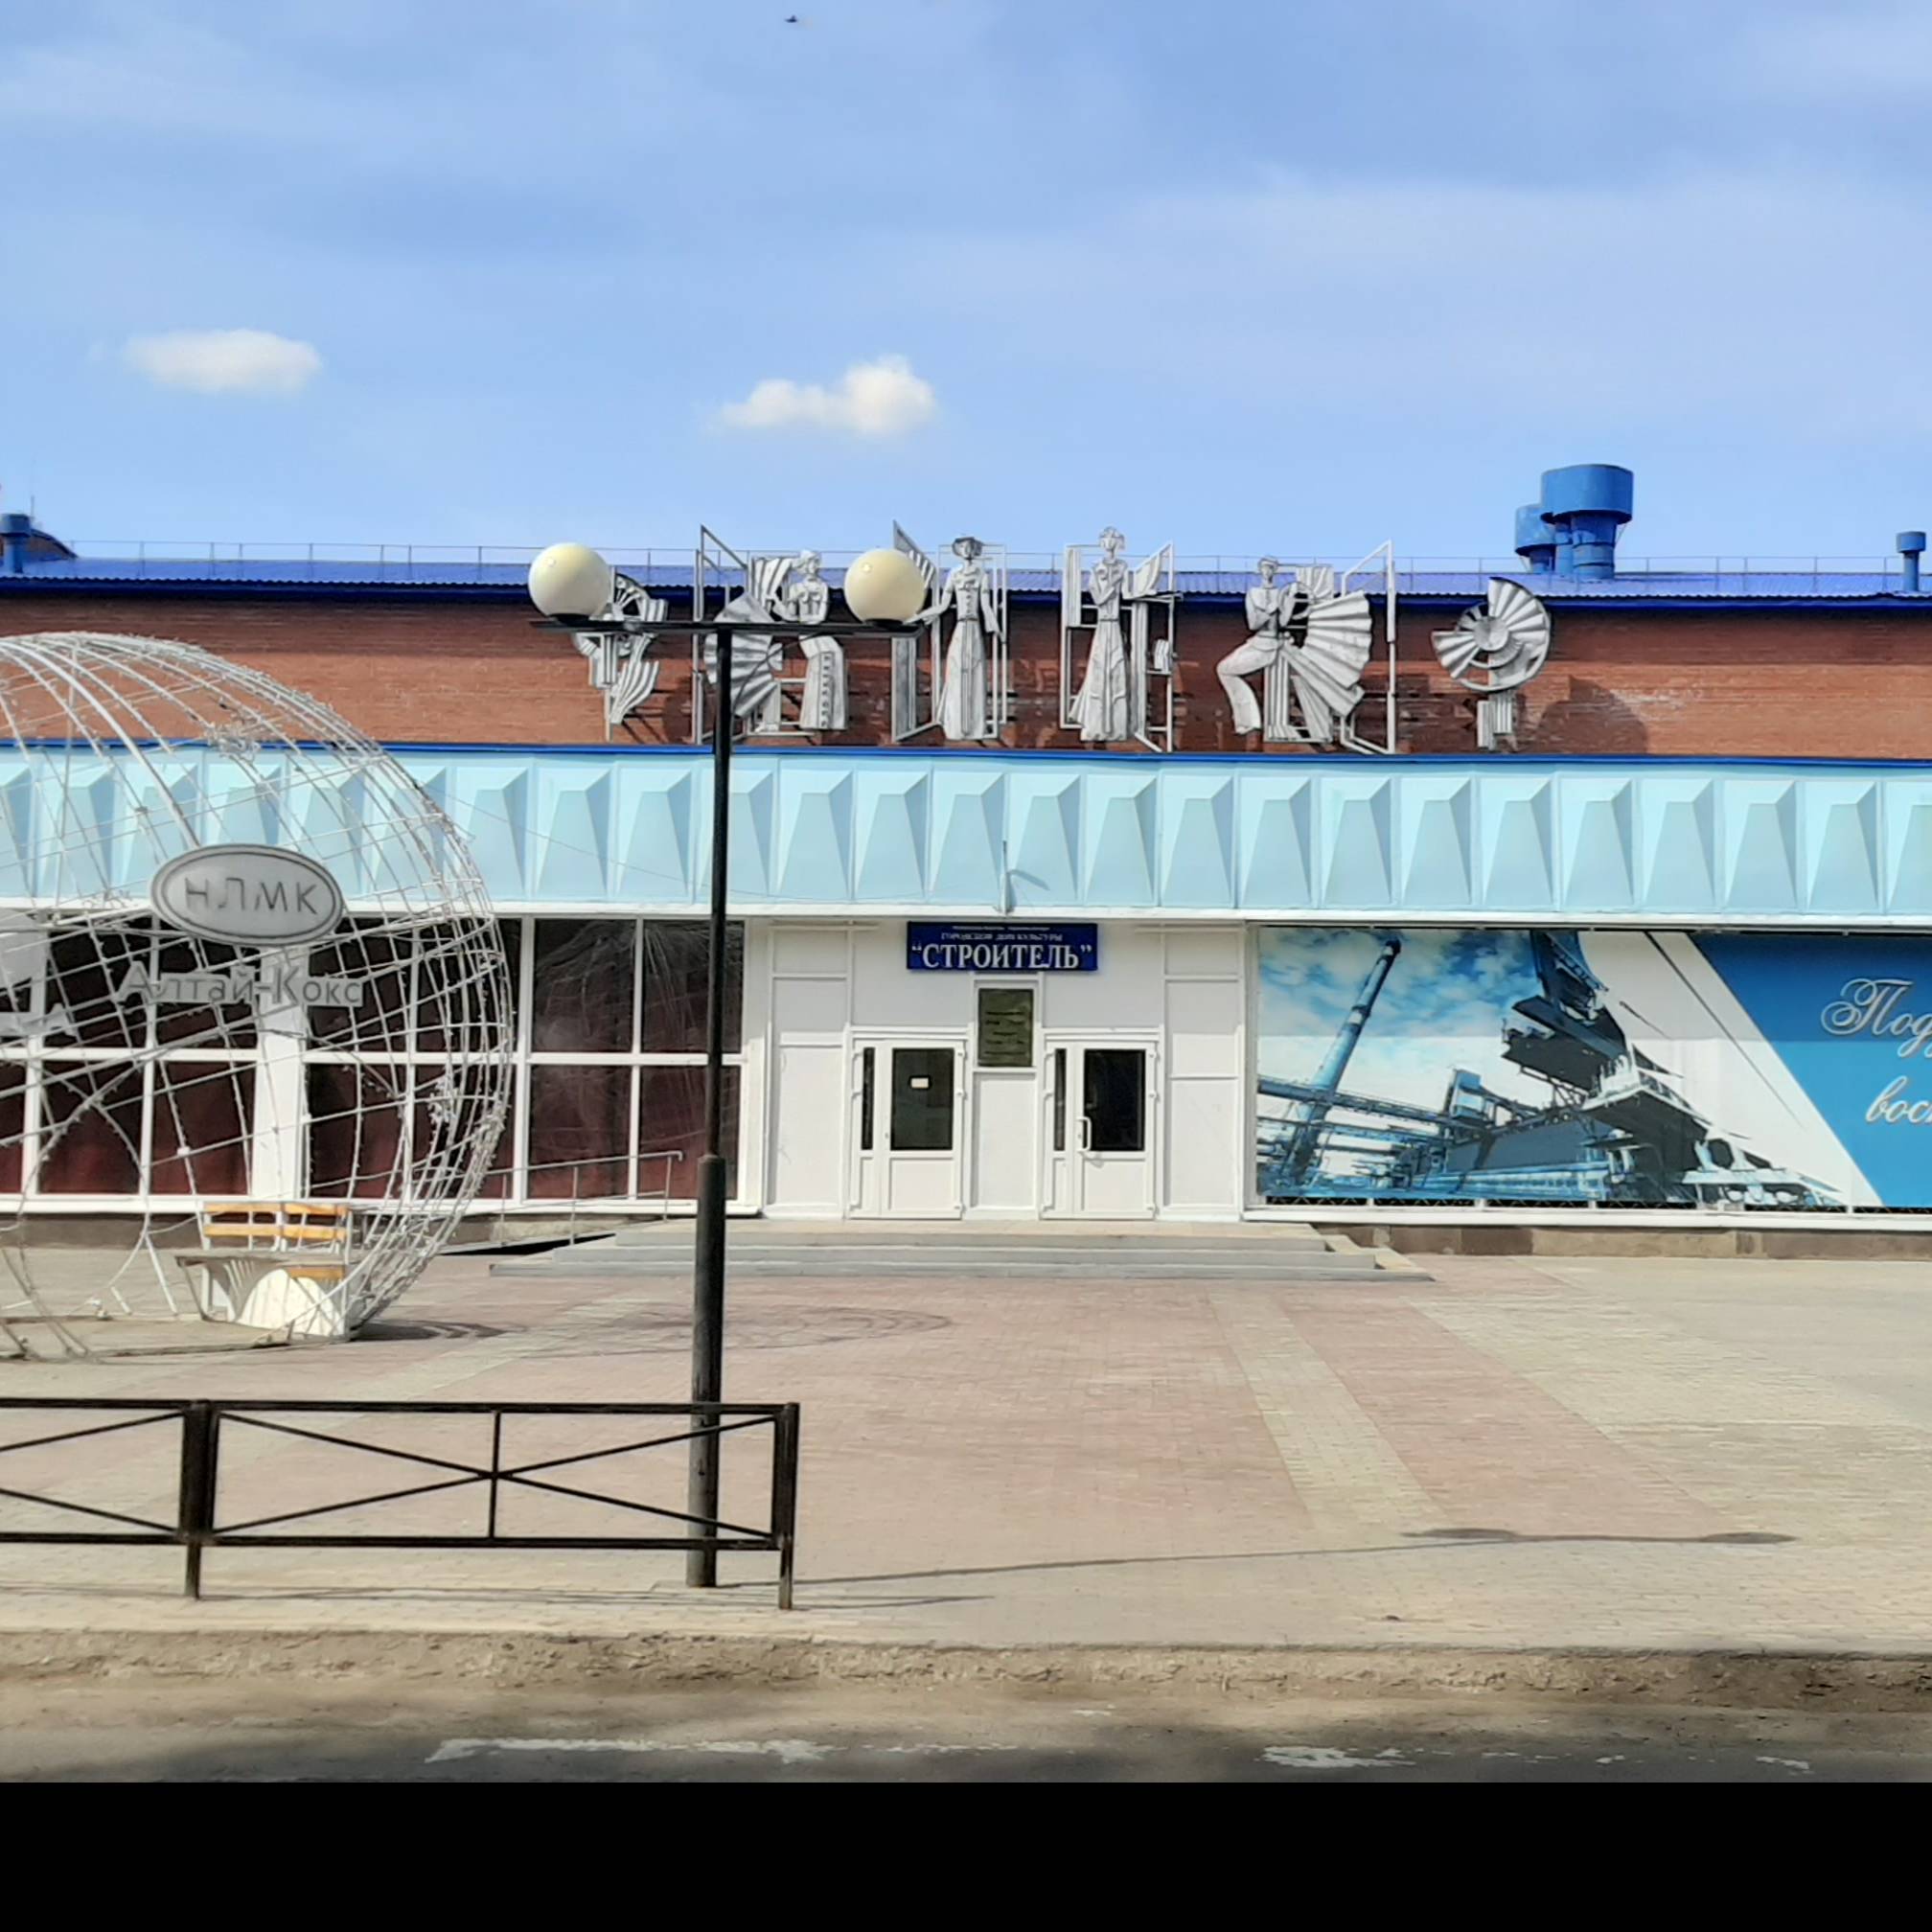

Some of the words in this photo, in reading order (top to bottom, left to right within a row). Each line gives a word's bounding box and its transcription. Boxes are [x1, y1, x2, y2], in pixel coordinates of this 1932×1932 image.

[184, 876, 318, 915] НЛМК
[119, 961, 361, 1005] Алтай-Кокс
[1821, 978, 1932, 1058] Под
[1865, 1075, 1932, 1123] вос
